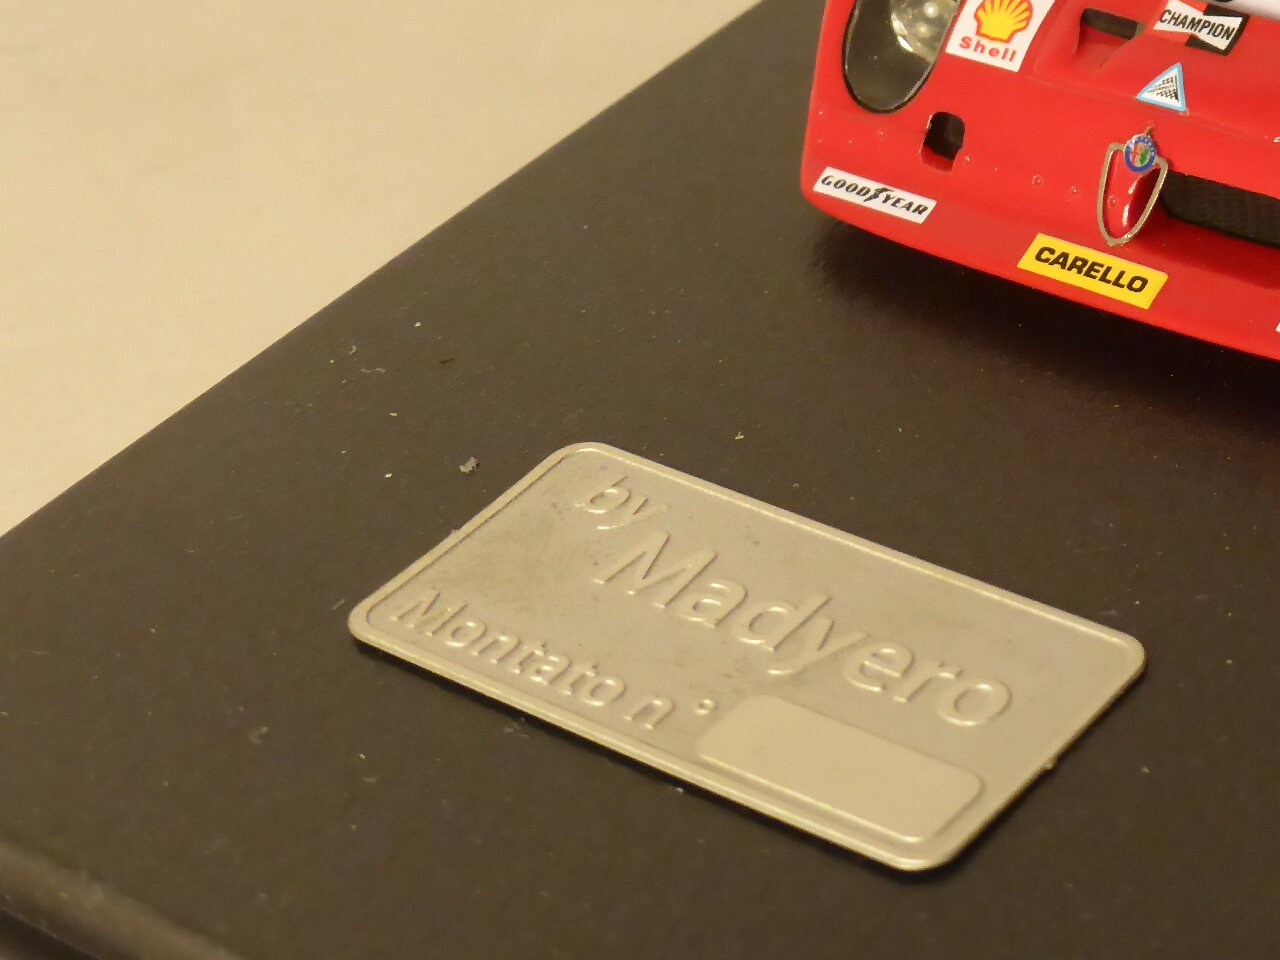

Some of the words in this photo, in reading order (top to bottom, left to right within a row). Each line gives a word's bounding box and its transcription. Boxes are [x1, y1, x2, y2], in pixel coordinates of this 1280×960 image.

[958, 35, 1018, 62] Shell
[1159, 8, 1236, 41] CHAMPION
[1034, 245, 1149, 293] CARELLO
[573, 474, 668, 530] by
[390, 590, 627, 707] Montato
[593, 529, 1012, 728] Madyero
